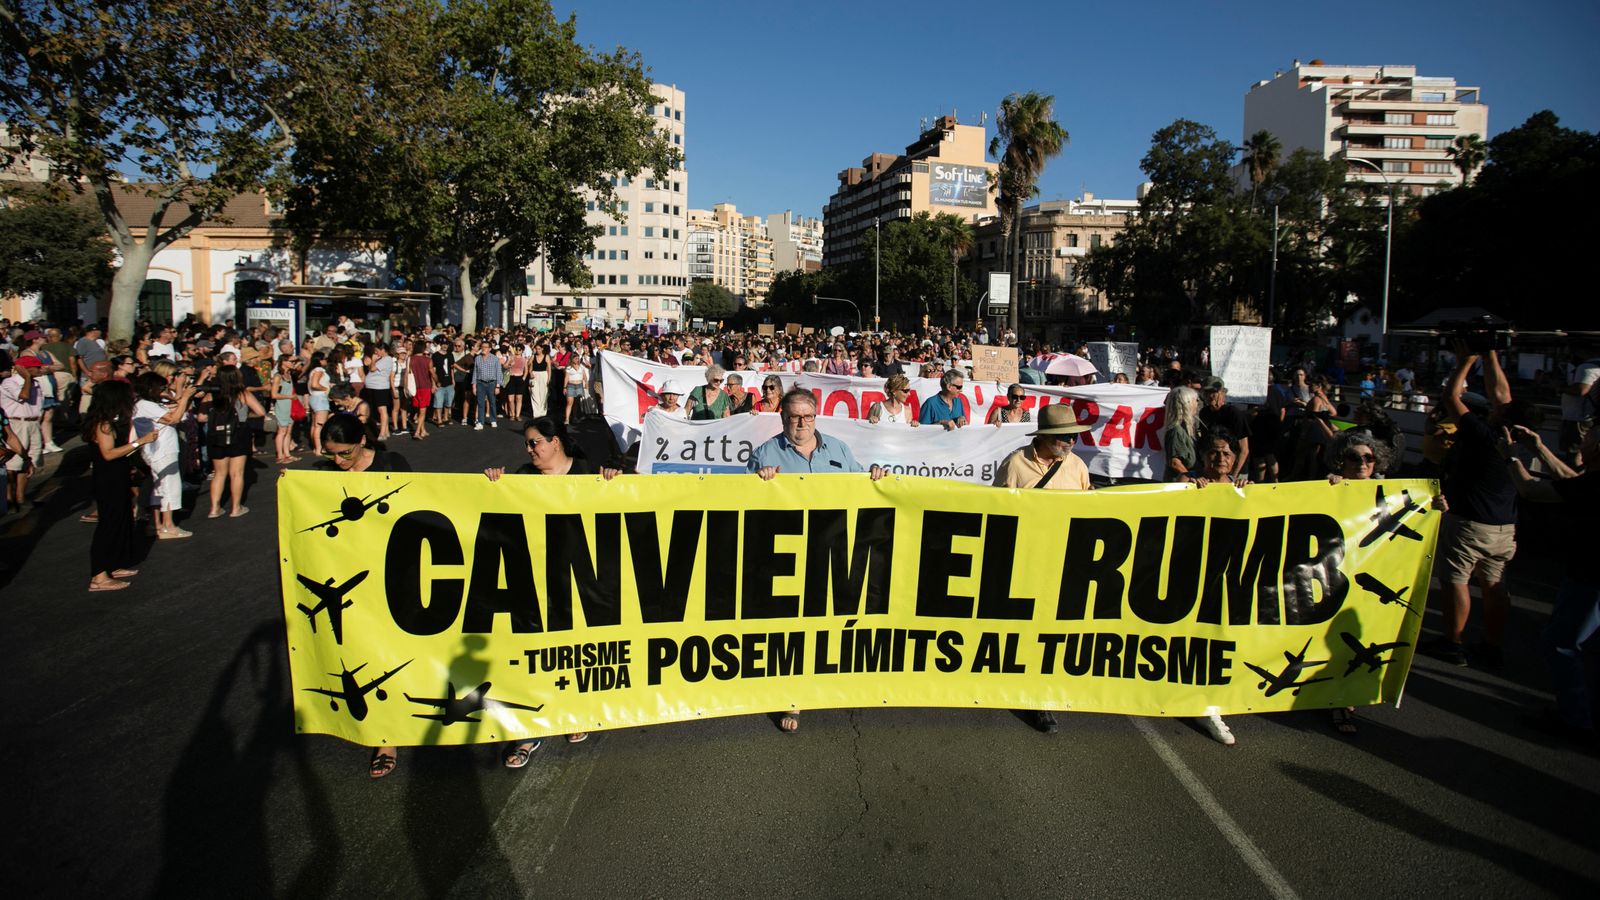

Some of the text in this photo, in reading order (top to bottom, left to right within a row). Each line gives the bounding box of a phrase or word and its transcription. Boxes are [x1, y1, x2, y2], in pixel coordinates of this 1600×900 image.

[384, 507, 1351, 636] CANVIEM EL RUMB
[524, 640, 631, 675] TURISME
[648, 619, 1236, 686] POSEM LÍMITS AL TURISME
[575, 665, 631, 693] VIDA
